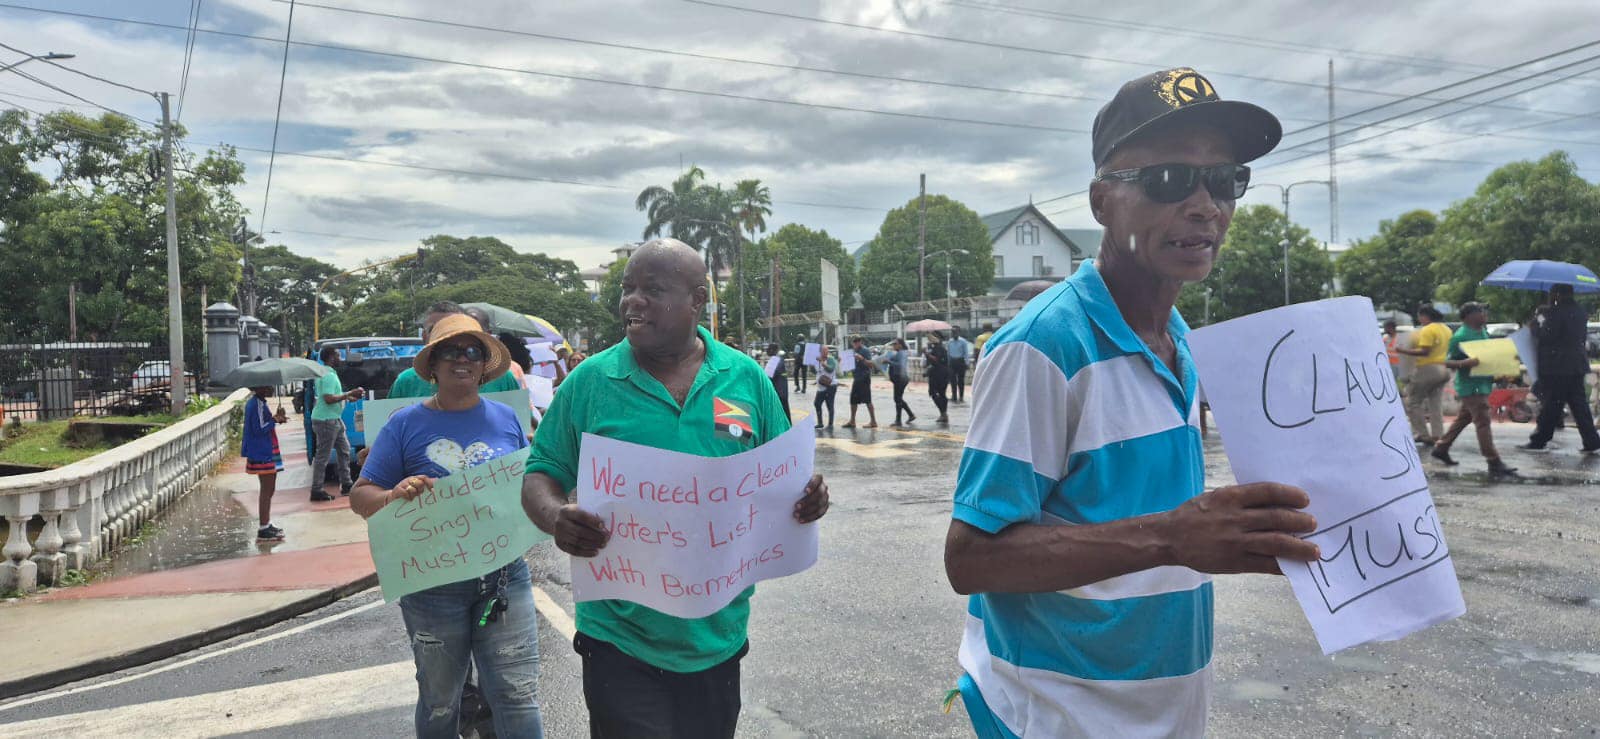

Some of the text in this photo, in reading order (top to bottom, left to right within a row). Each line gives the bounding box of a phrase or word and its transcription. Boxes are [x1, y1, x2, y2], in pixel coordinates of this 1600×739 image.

[394, 460, 525, 518] Claudette
[591, 456, 626, 497] We
[638, 477, 699, 505] need
[708, 486, 728, 502] a
[410, 503, 495, 542] Singh
[708, 504, 759, 548] List
[401, 534, 509, 579] Must go
[589, 544, 784, 597] With Biometrics
